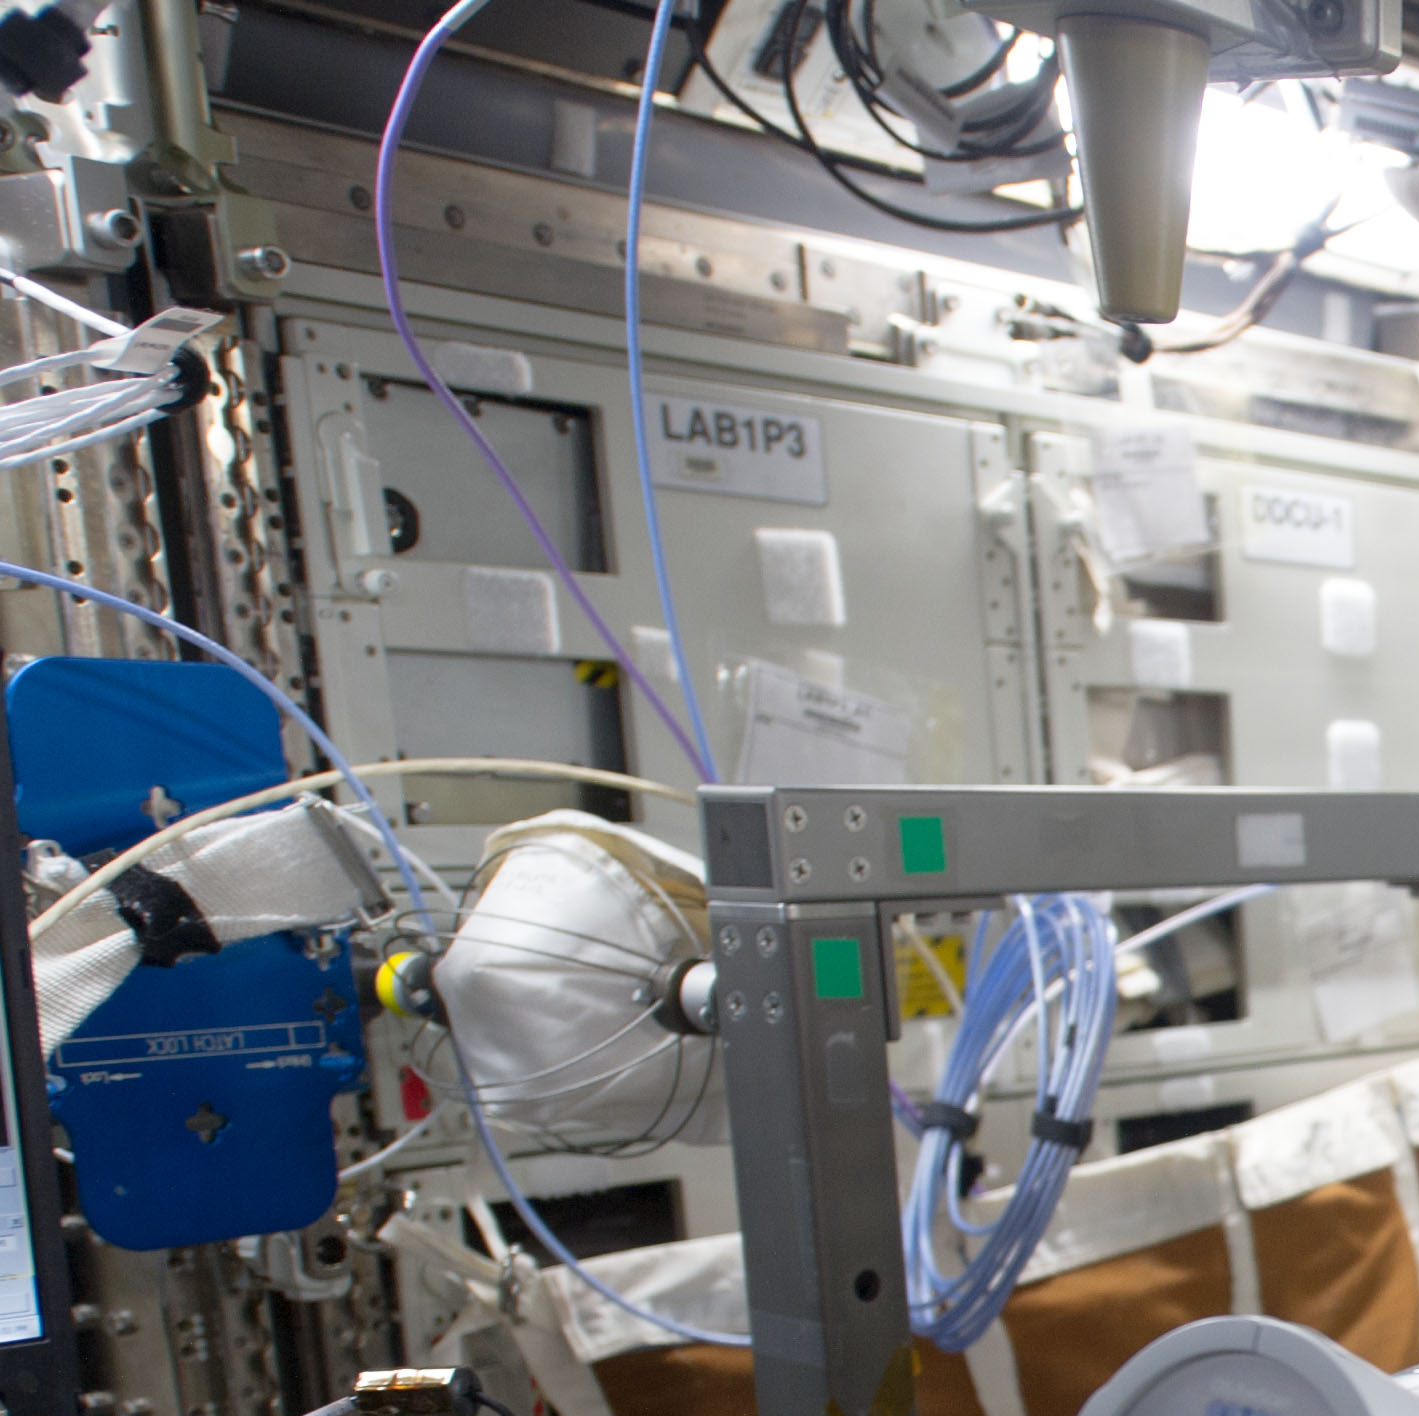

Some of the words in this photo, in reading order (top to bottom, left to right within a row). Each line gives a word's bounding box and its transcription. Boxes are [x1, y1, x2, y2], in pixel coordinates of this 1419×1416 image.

[660, 403, 807, 459] LAB1P3
[147, 1035, 189, 1055] LOCK
[193, 1031, 245, 1050] LATCH
